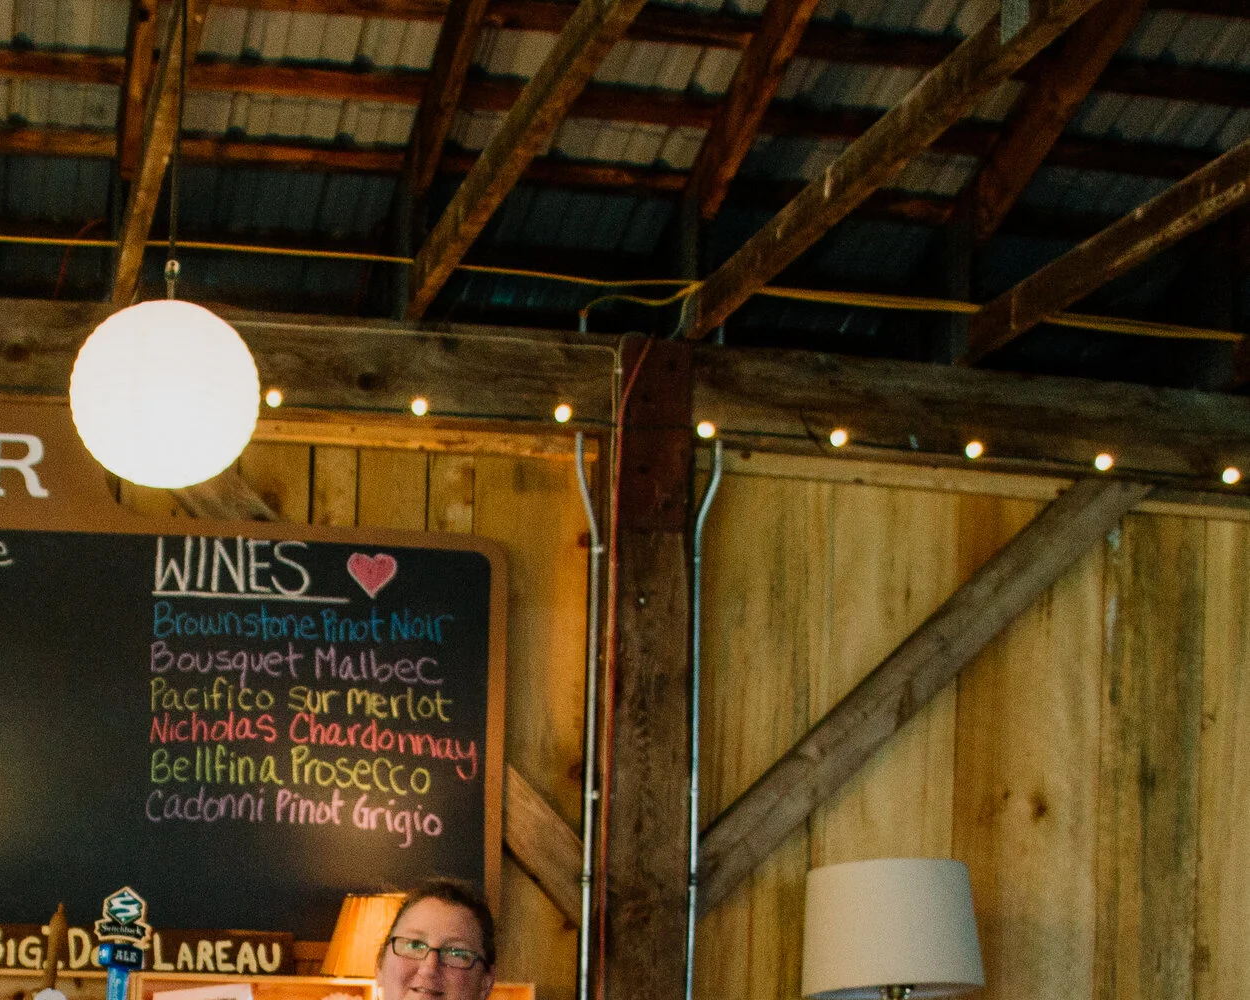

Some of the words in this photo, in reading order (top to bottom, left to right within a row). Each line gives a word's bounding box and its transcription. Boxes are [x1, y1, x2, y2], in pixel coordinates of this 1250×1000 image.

[154, 535, 310, 596] WINES
[153, 601, 318, 640] Brownstone
[320, 607, 385, 642] Pinot
[390, 608, 454, 643] Noir
[150, 640, 303, 689] Bousquet
[315, 644, 444, 685] Malbec
[150, 676, 274, 713] Pacifico
[150, 712, 278, 744] Nicholas
[289, 712, 478, 780] Chardonnay
[151, 745, 284, 785] Bellfina
[291, 745, 432, 796] Prosecco
[276, 789, 345, 825] Pinot
[353, 794, 443, 849] Grigio
[114, 949, 138, 963] ALE
